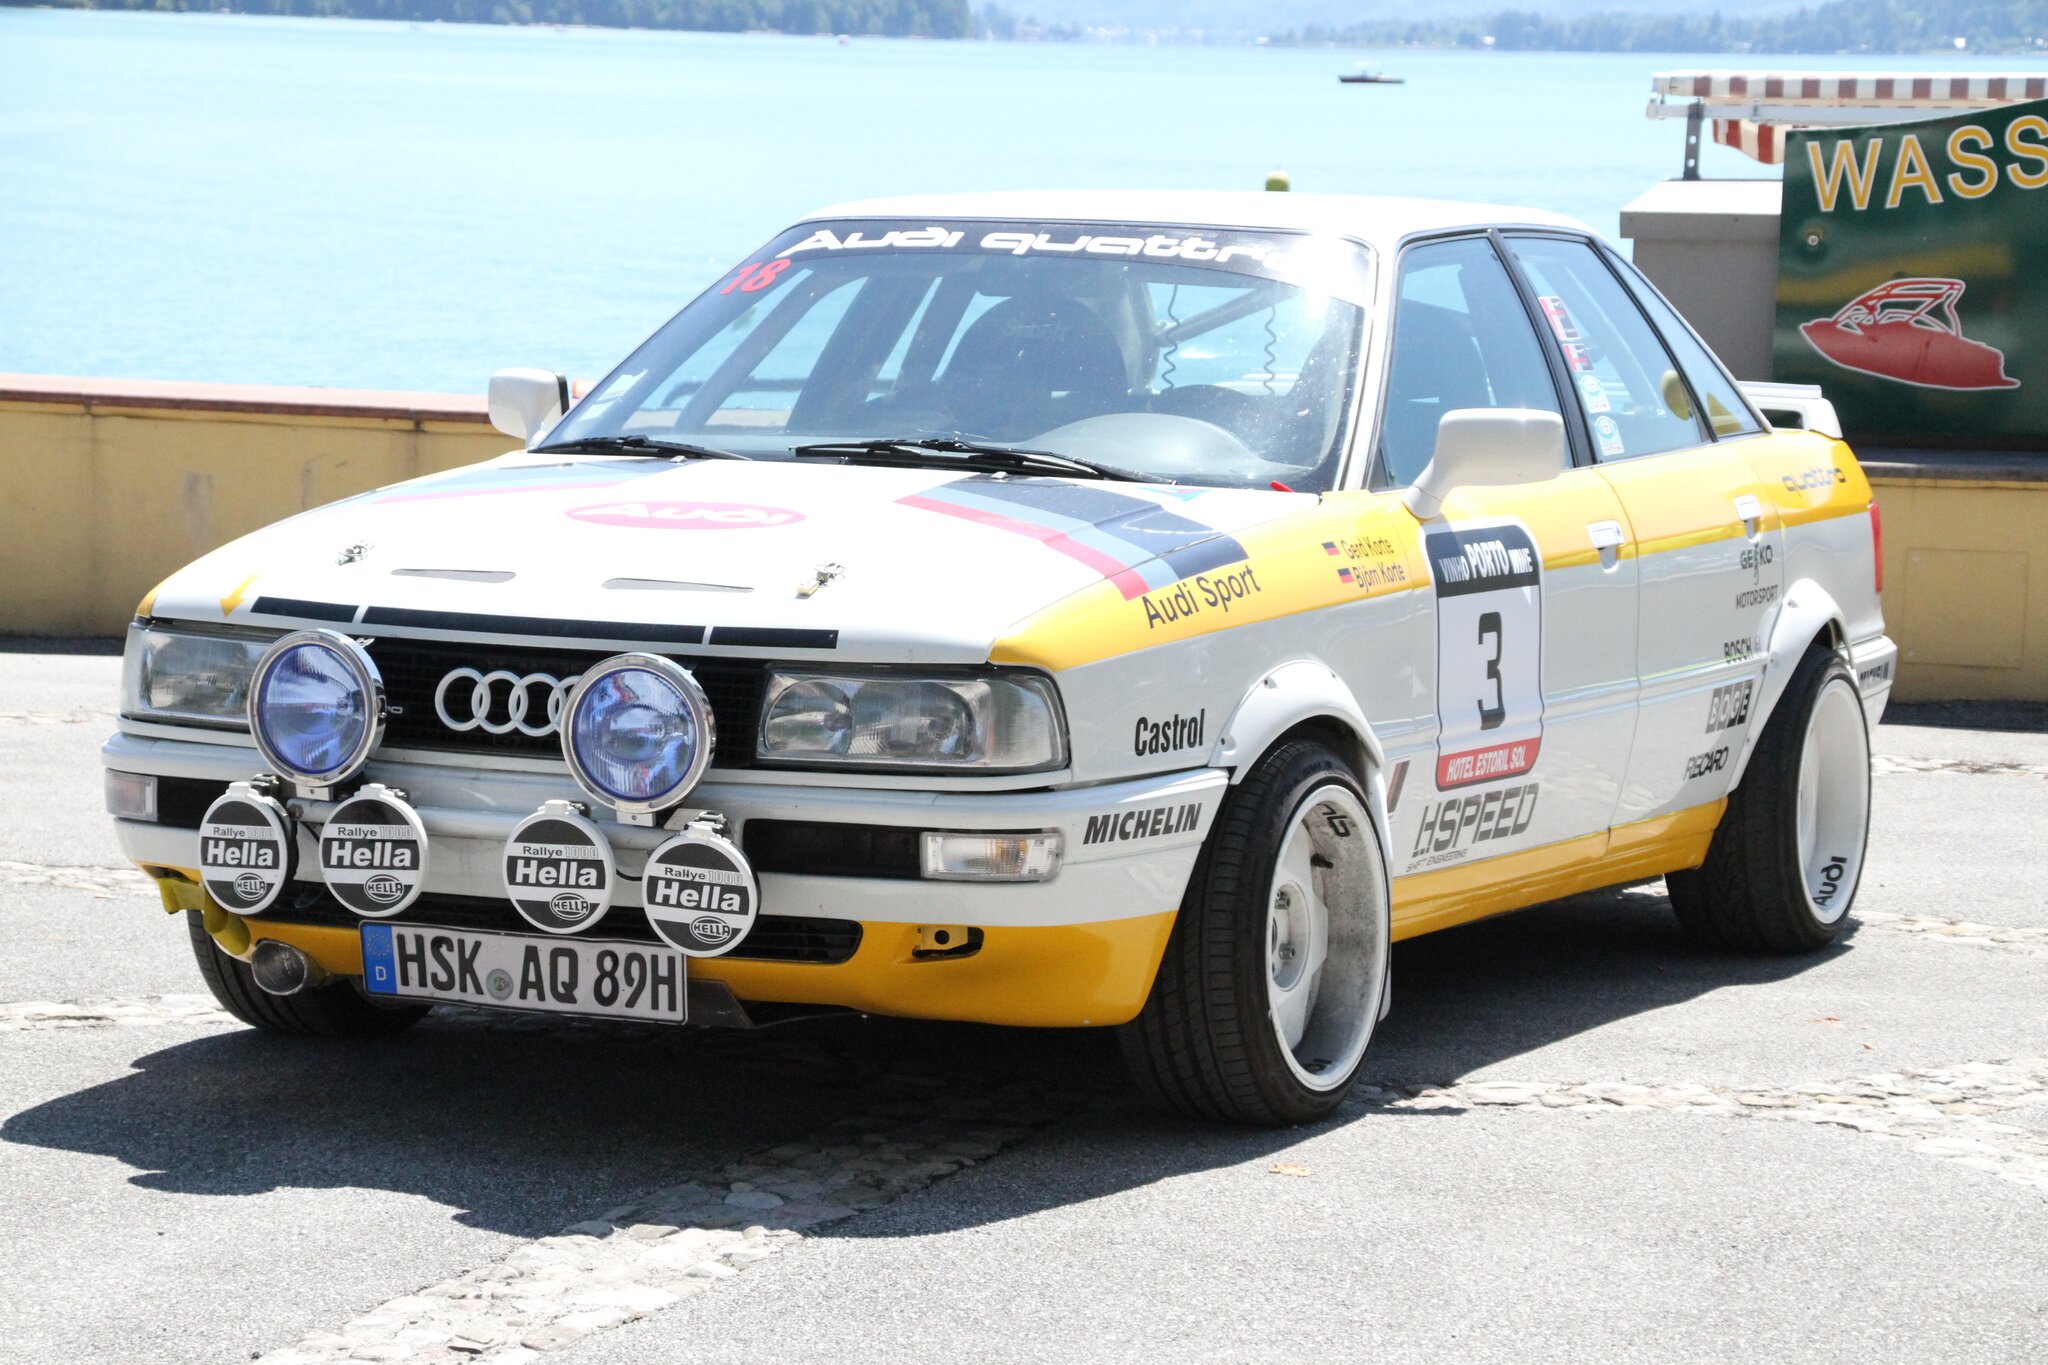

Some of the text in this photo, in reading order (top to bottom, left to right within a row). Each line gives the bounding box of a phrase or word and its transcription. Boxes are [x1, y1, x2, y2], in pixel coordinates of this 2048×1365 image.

[1806, 115, 2048, 212] WASS
[775, 227, 965, 258] Audi
[720, 258, 791, 294] 18
[572, 503, 793, 525] Audi
[1340, 536, 1394, 560] Gerd Korte
[1464, 540, 1510, 578] PORTO
[1378, 562, 1406, 583] Korte
[1141, 565, 1262, 629] Audi Sport
[1736, 584, 1778, 610] MOTORSPORT
[1477, 611, 1505, 731] 3
[1134, 708, 1206, 757] Castrol
[1446, 745, 1527, 782] HOTEL ESTORIL SOL
[1683, 746, 1729, 781] RECARO
[213, 827, 246, 840] Rallye
[337, 826, 378, 840] Rallye
[1083, 802, 1203, 845] MICHELIN
[206, 840, 274, 867] Hella
[329, 841, 413, 868] Hella
[522, 846, 563, 859] Rallye
[236, 880, 267, 893] HELLA
[515, 859, 598, 887] Hella
[664, 867, 706, 882] Rallye
[1812, 856, 1848, 907] Audi
[367, 882, 403, 895] HELLA
[654, 880, 742, 912] Hella
[553, 900, 590, 913] HELLA
[693, 922, 731, 938] HELLA
[375, 965, 387, 981] D
[396, 933, 485, 995] HSK
[519, 944, 580, 1005] AQ
[594, 949, 678, 1013] 89H
